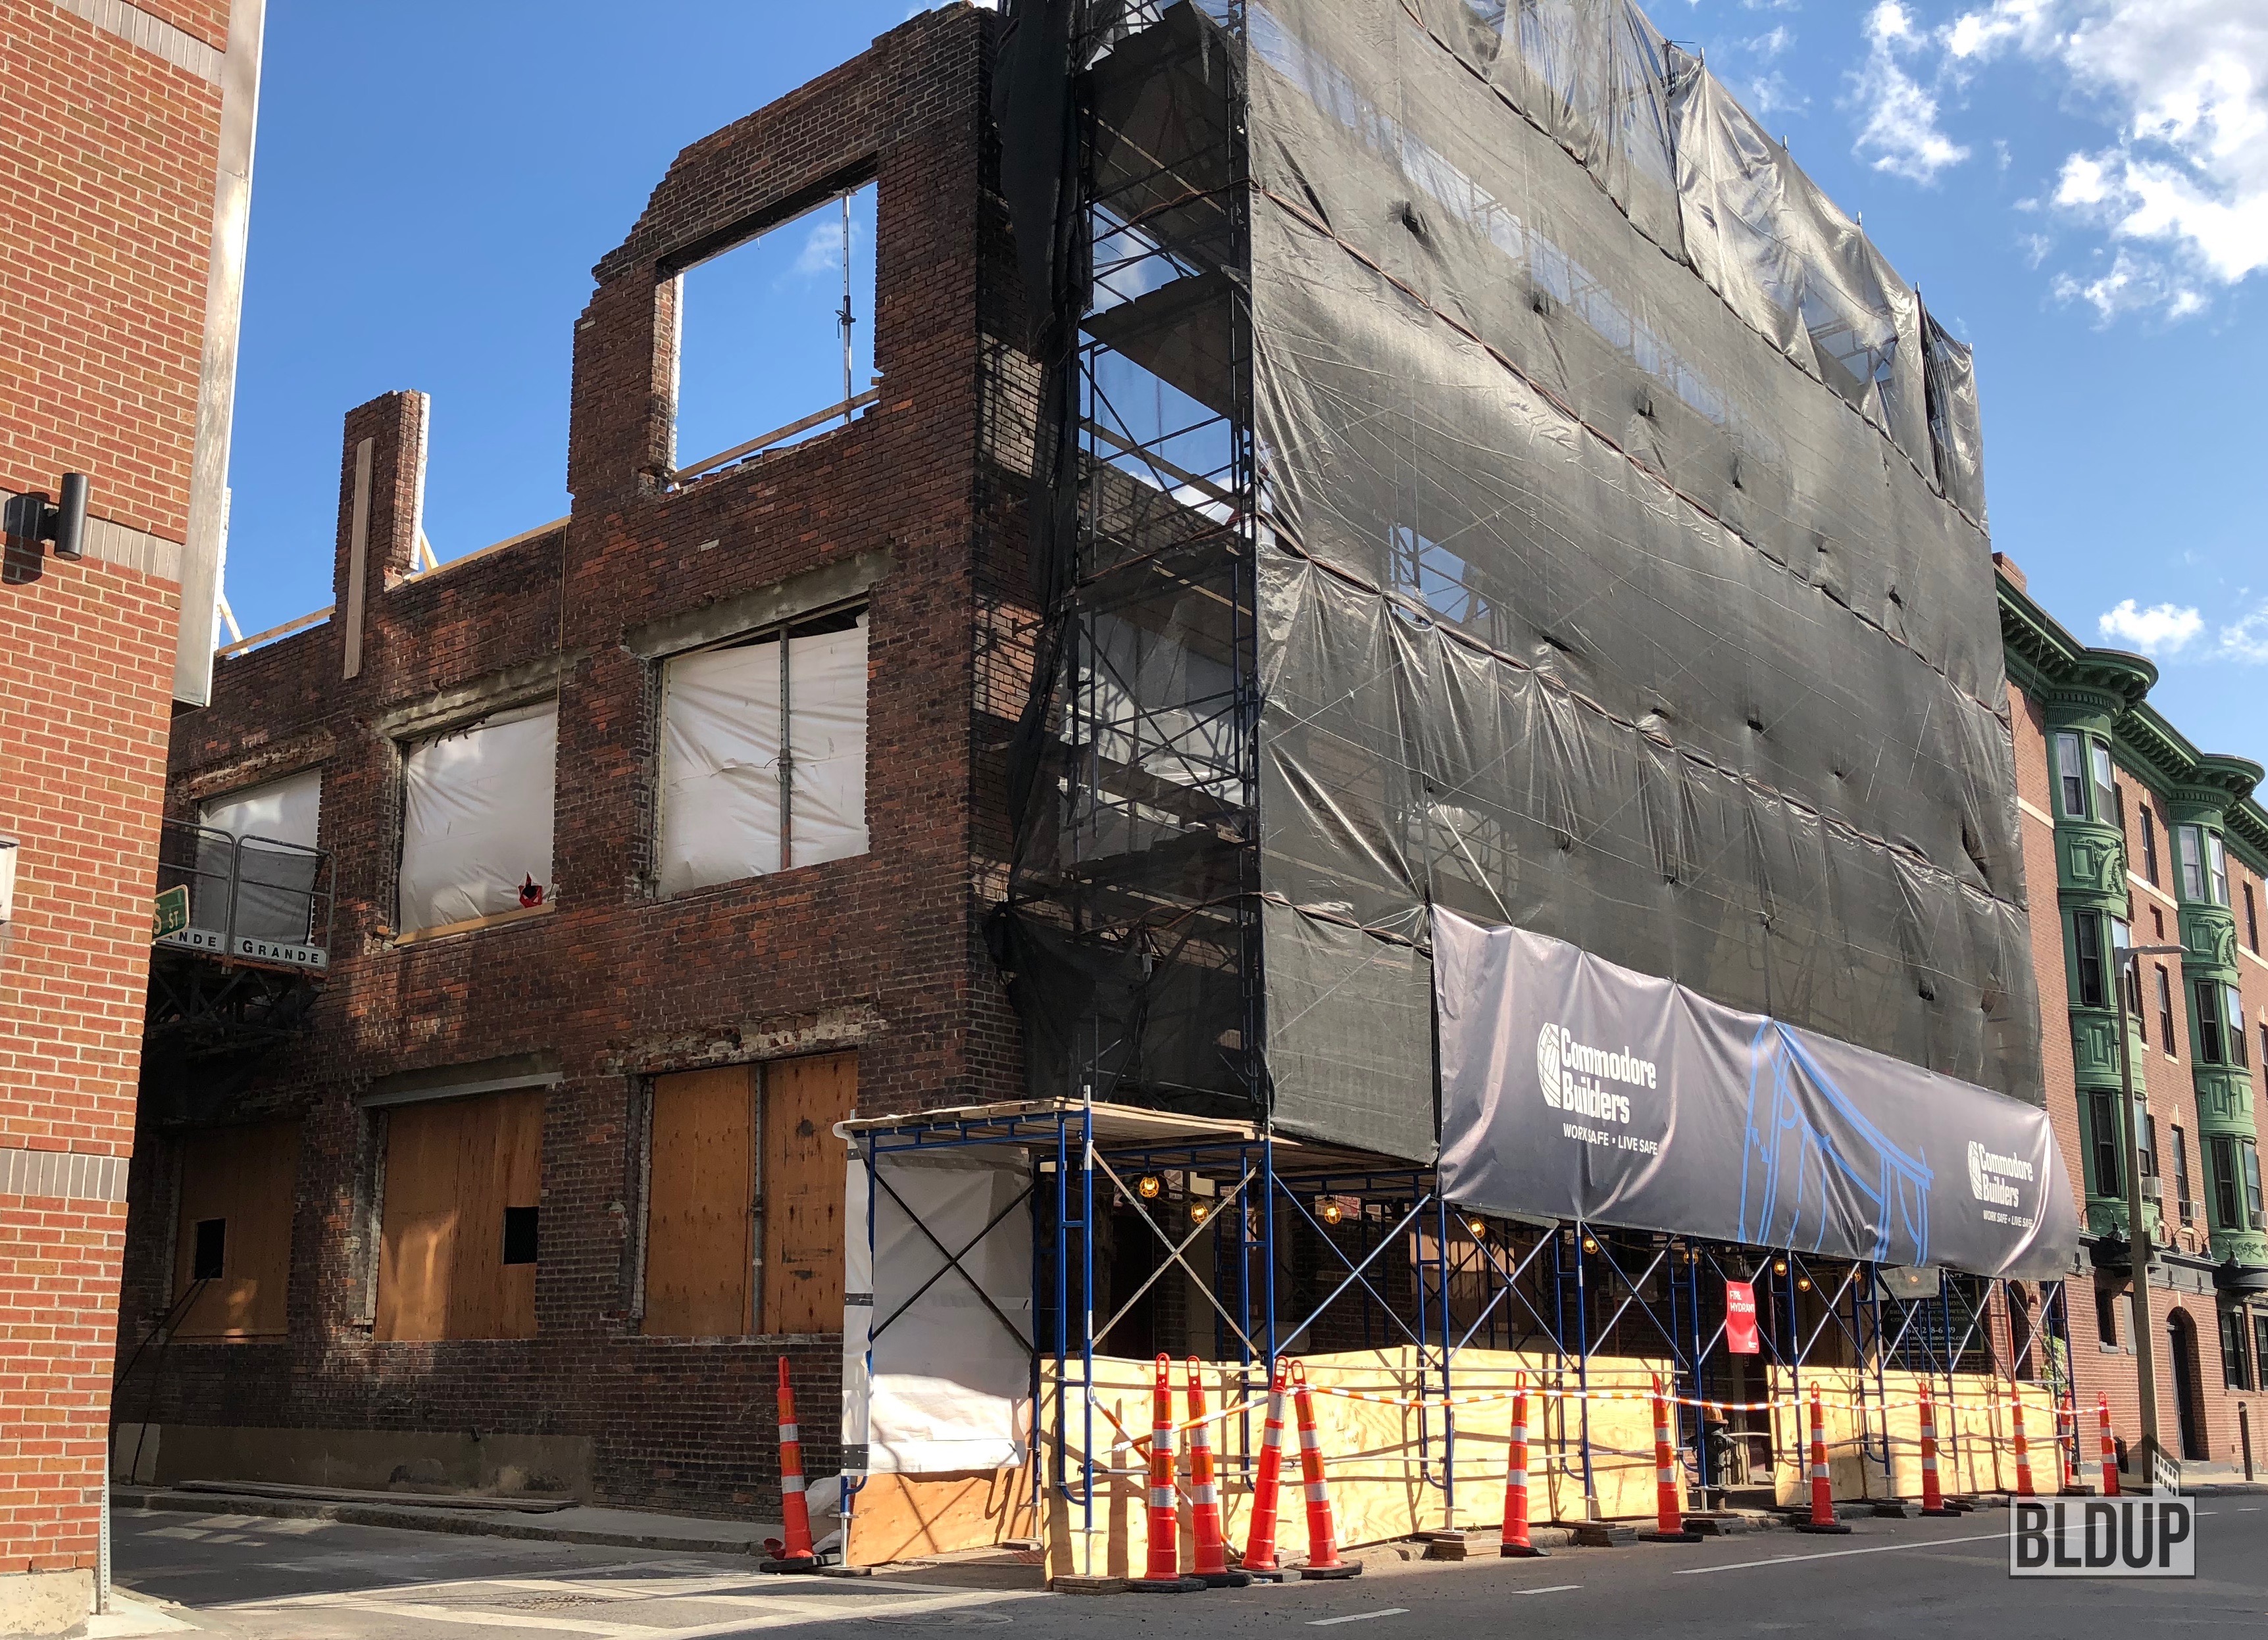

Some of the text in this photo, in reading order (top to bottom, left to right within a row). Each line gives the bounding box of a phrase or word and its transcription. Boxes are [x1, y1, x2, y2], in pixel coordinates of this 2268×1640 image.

[169, 910, 178, 929] ST
[1561, 1027, 1657, 1089] Commodore
[1562, 1070, 1630, 1124] Builders
[1619, 1135, 1638, 1151] LIVE
[1639, 1139, 1658, 1155] SAFE
[1978, 1143, 2033, 1181] Commodore
[1982, 1174, 2019, 1208] Builders
[1983, 1210, 2033, 1228] WORK SAFE LIVE SAFE
[1730, 1303, 1755, 1312] HYDRANT
